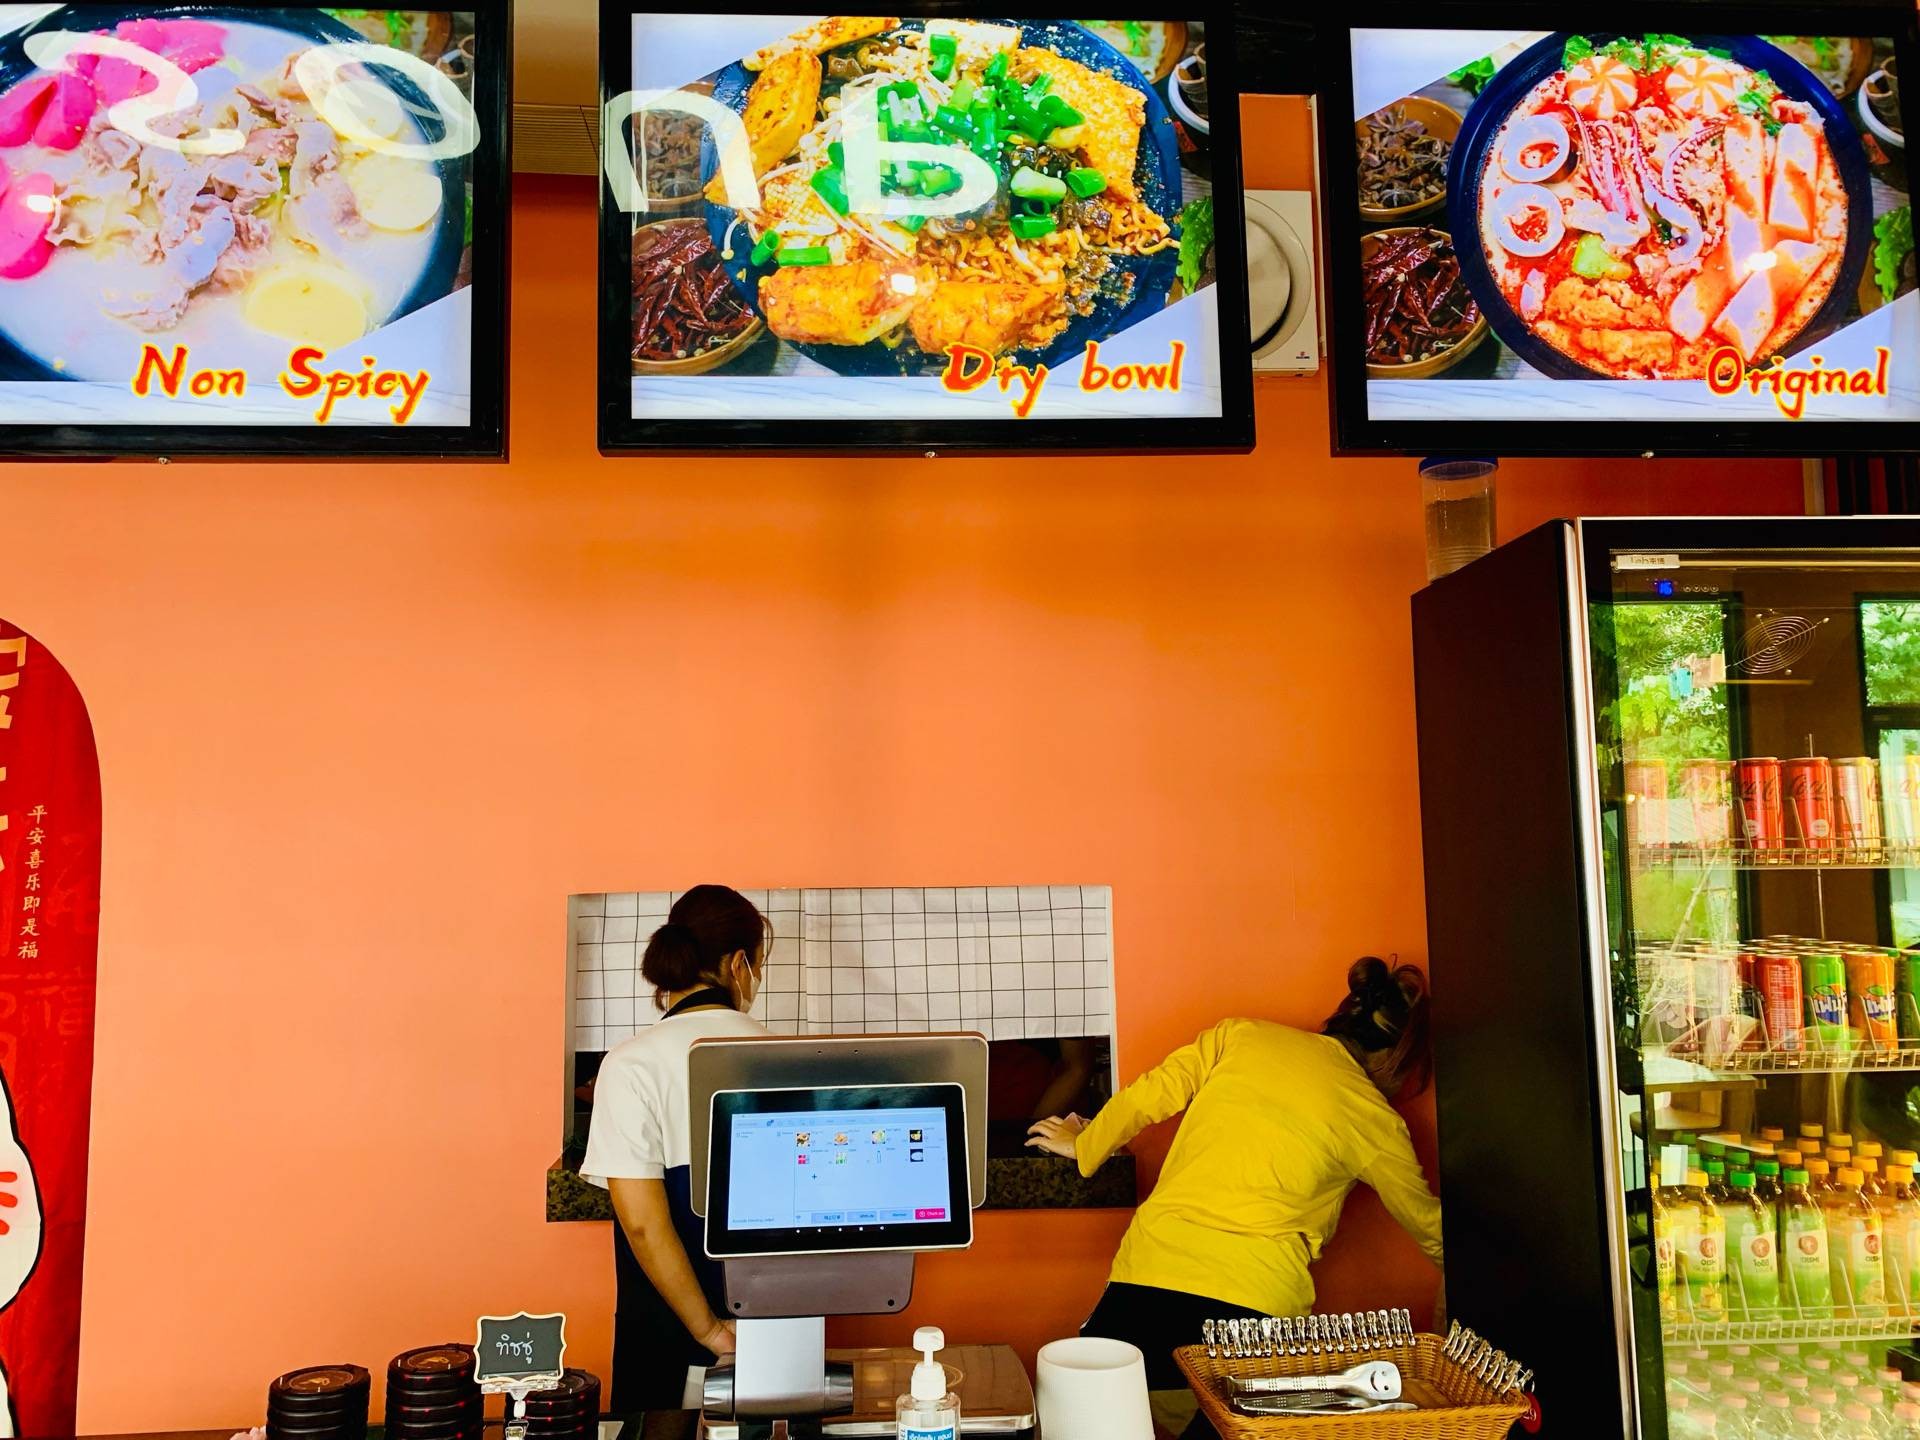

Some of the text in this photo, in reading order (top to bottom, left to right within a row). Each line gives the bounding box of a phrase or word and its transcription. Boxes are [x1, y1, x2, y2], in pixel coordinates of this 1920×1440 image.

[132, 344, 429, 424] Non Spicy
[943, 340, 1186, 418] Dry bowl
[1707, 346, 1890, 420] Original
[17, 804, 48, 960] 平安喜乐即是福
